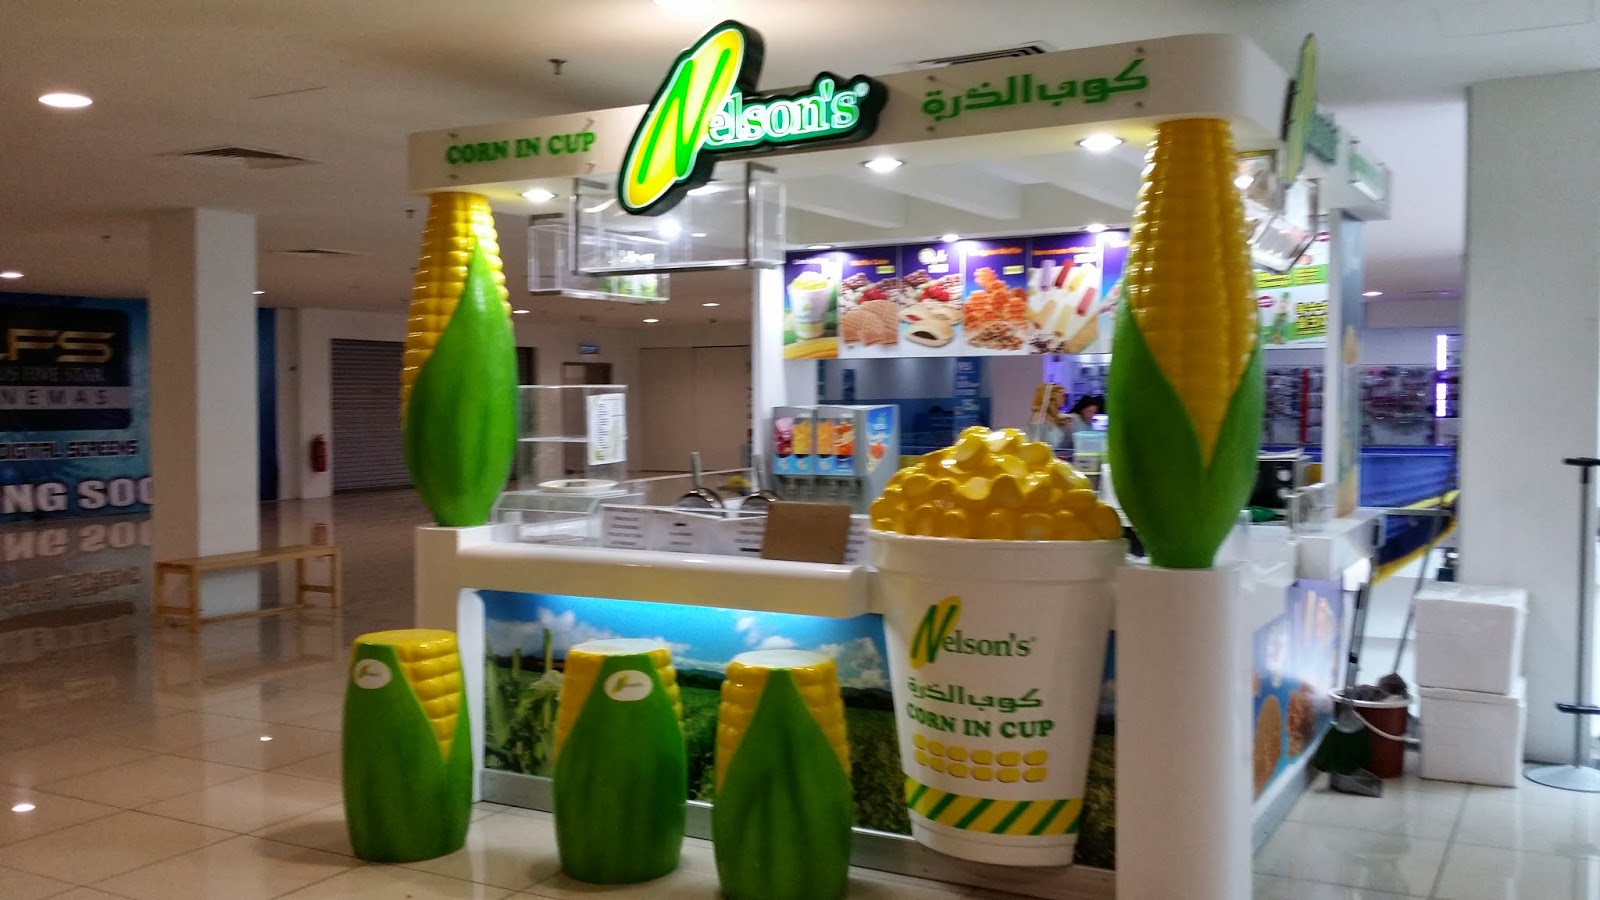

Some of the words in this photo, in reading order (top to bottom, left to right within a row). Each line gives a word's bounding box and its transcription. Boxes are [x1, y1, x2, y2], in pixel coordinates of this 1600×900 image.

[1036, 58, 1149, 107] كوب
[446, 140, 509, 165] CORN
[515, 136, 542, 158] IN
[548, 132, 595, 155] CUP
[911, 601, 1032, 664] Nelson's
[969, 688, 1043, 713] كوب
[906, 703, 956, 734] CORN
[963, 719, 991, 738] IN
[1001, 719, 1055, 739] CUP
